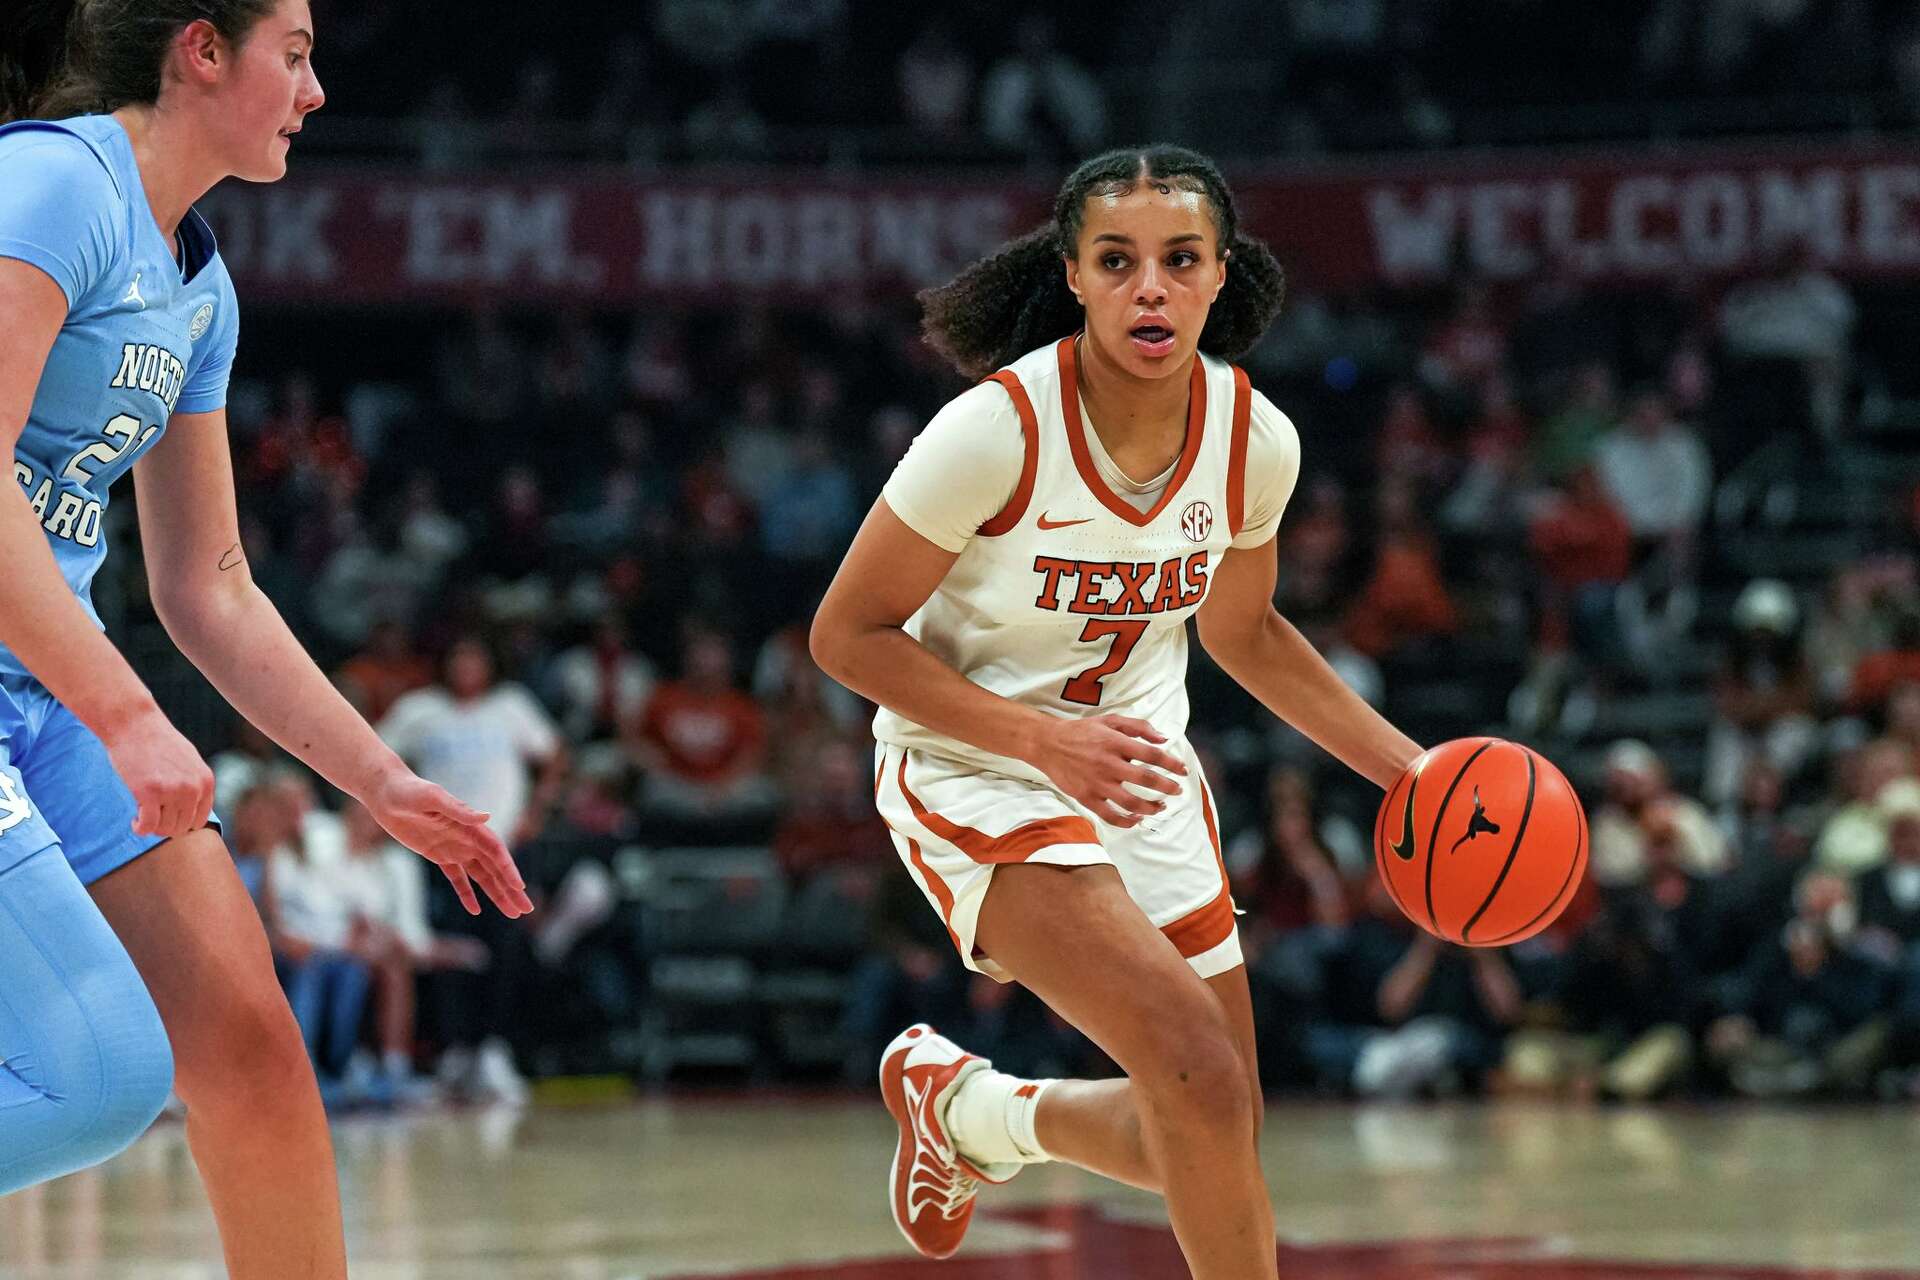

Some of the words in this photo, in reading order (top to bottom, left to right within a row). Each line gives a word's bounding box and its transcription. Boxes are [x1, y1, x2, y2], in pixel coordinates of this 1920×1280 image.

[1363, 165, 1920, 288] WELCOME
[1181, 501, 1213, 542] SEC
[1033, 550, 1208, 615] TEXAS
[1060, 617, 1150, 706] 7
